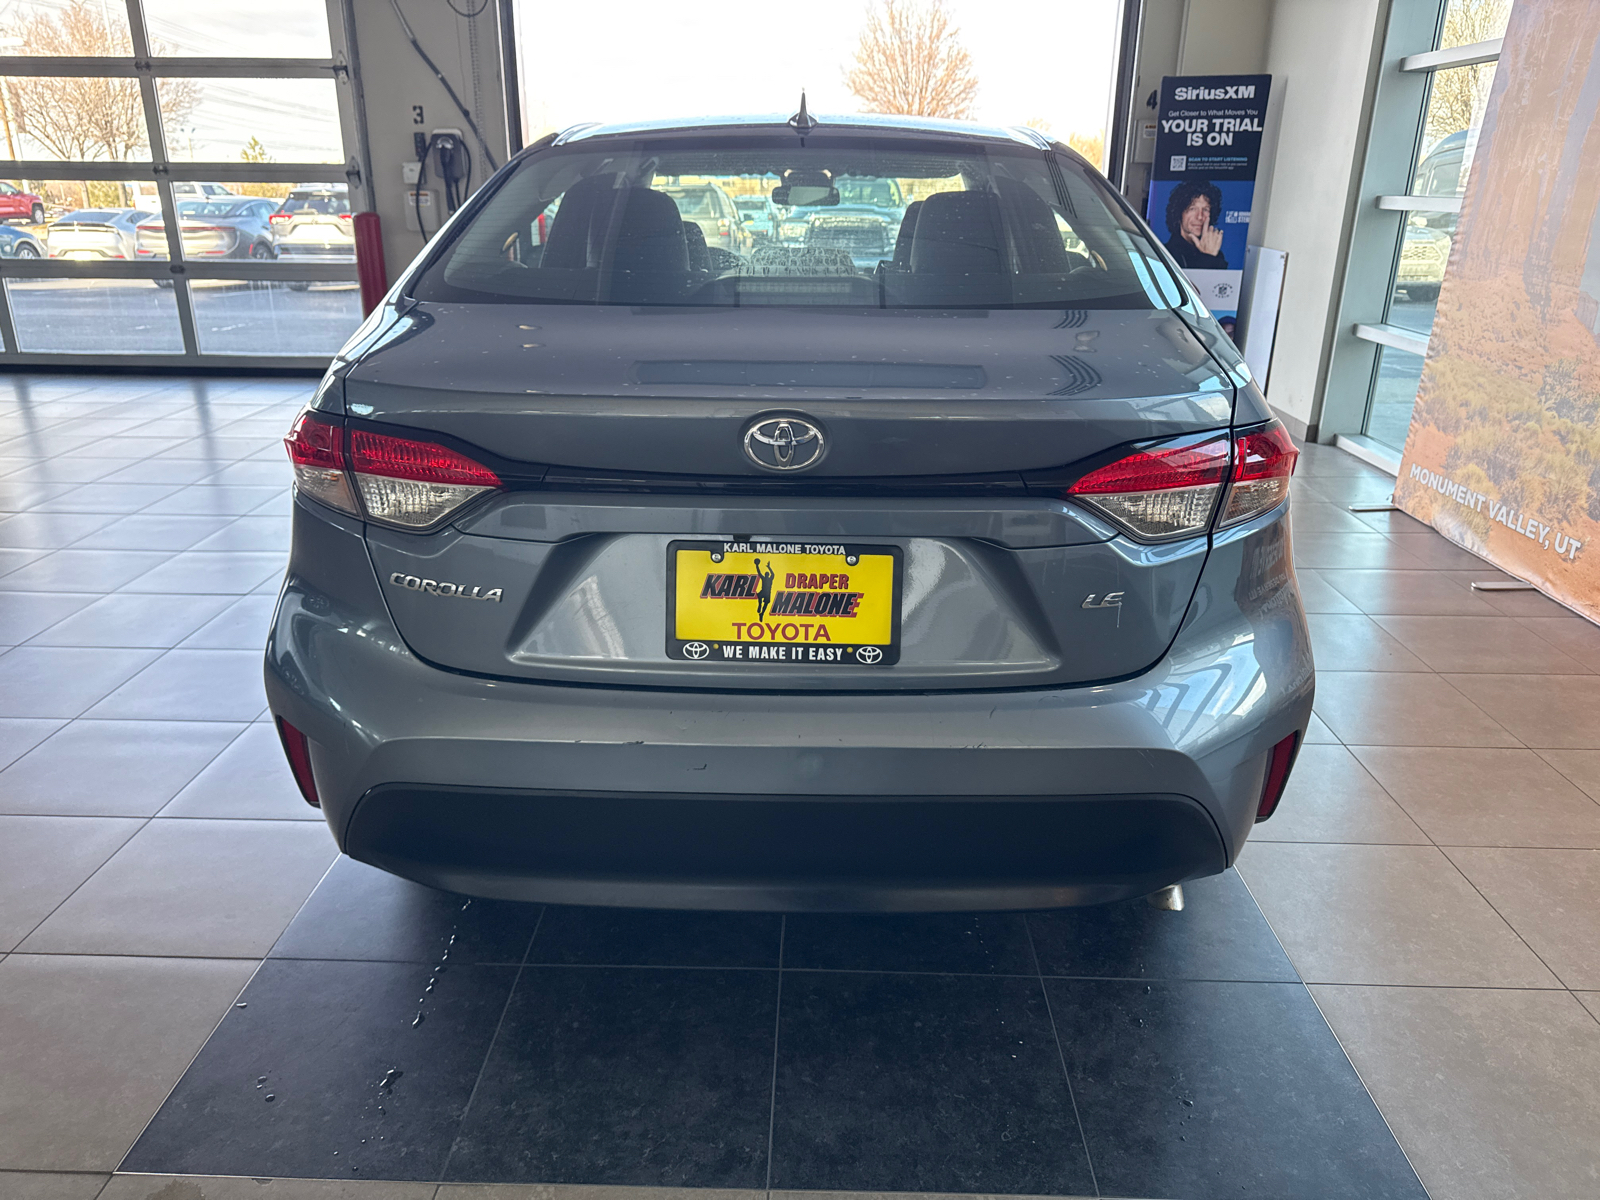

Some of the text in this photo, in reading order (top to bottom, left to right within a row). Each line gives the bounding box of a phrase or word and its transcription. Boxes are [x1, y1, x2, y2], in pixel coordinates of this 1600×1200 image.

[1146, 89, 1158, 110] 4
[1174, 85, 1256, 100] SiriusXM
[412, 105, 424, 124] 3
[1161, 118, 1209, 133] YOUR
[1212, 118, 1263, 132] TRIAL
[1186, 132, 1234, 147] IS ON
[1409, 463, 1582, 559] MONUMENT VALLEY, UT
[723, 542, 846, 555] KARL MALONE TOYOTA
[389, 571, 503, 603] COROLLA
[700, 573, 762, 599] KARL
[785, 572, 850, 590] DRAPER
[769, 590, 864, 618] MALONE
[1081, 591, 1125, 609] LE
[731, 622, 832, 642] TOYOTA
[722, 645, 843, 661] WE MAKE IT EASY
